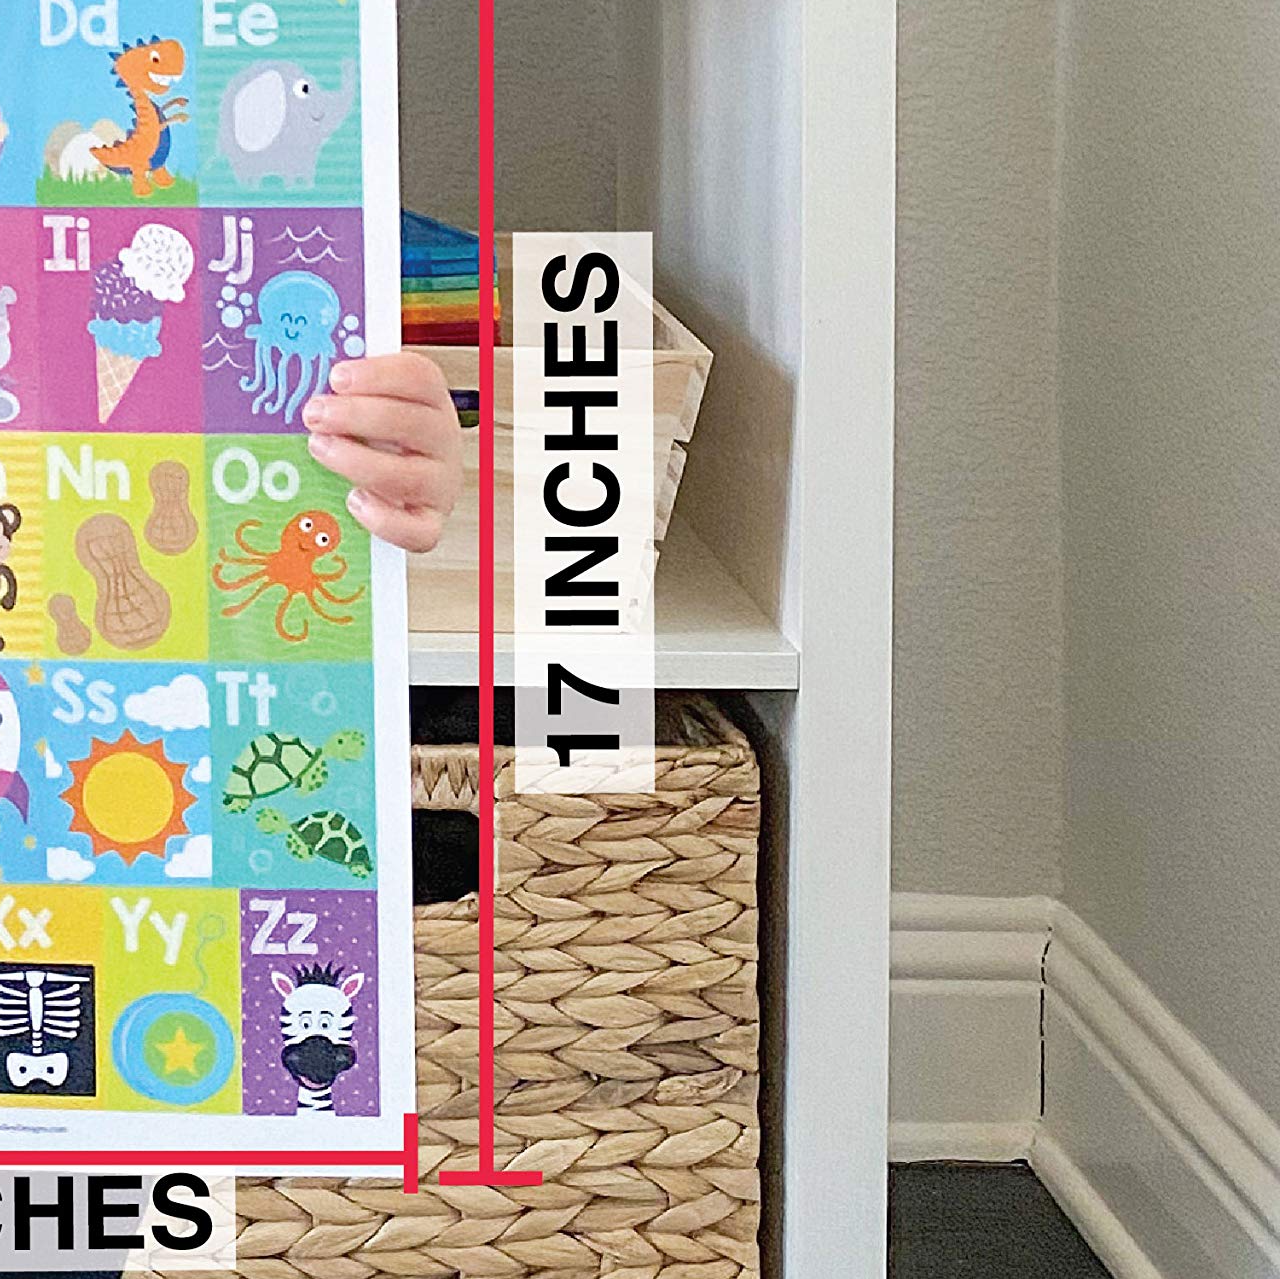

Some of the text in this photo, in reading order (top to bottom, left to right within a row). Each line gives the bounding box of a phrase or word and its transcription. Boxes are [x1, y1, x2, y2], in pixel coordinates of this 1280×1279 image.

[43, 215, 90, 273] Ii
[207, 215, 254, 285] Jj
[47, 444, 129, 500] Nn
[213, 444, 299, 501] Oo
[52, 668, 117, 724] Ss
[216, 670, 275, 725] Tt
[112, 897, 187, 966] Yy
[248, 899, 317, 955] Zz
